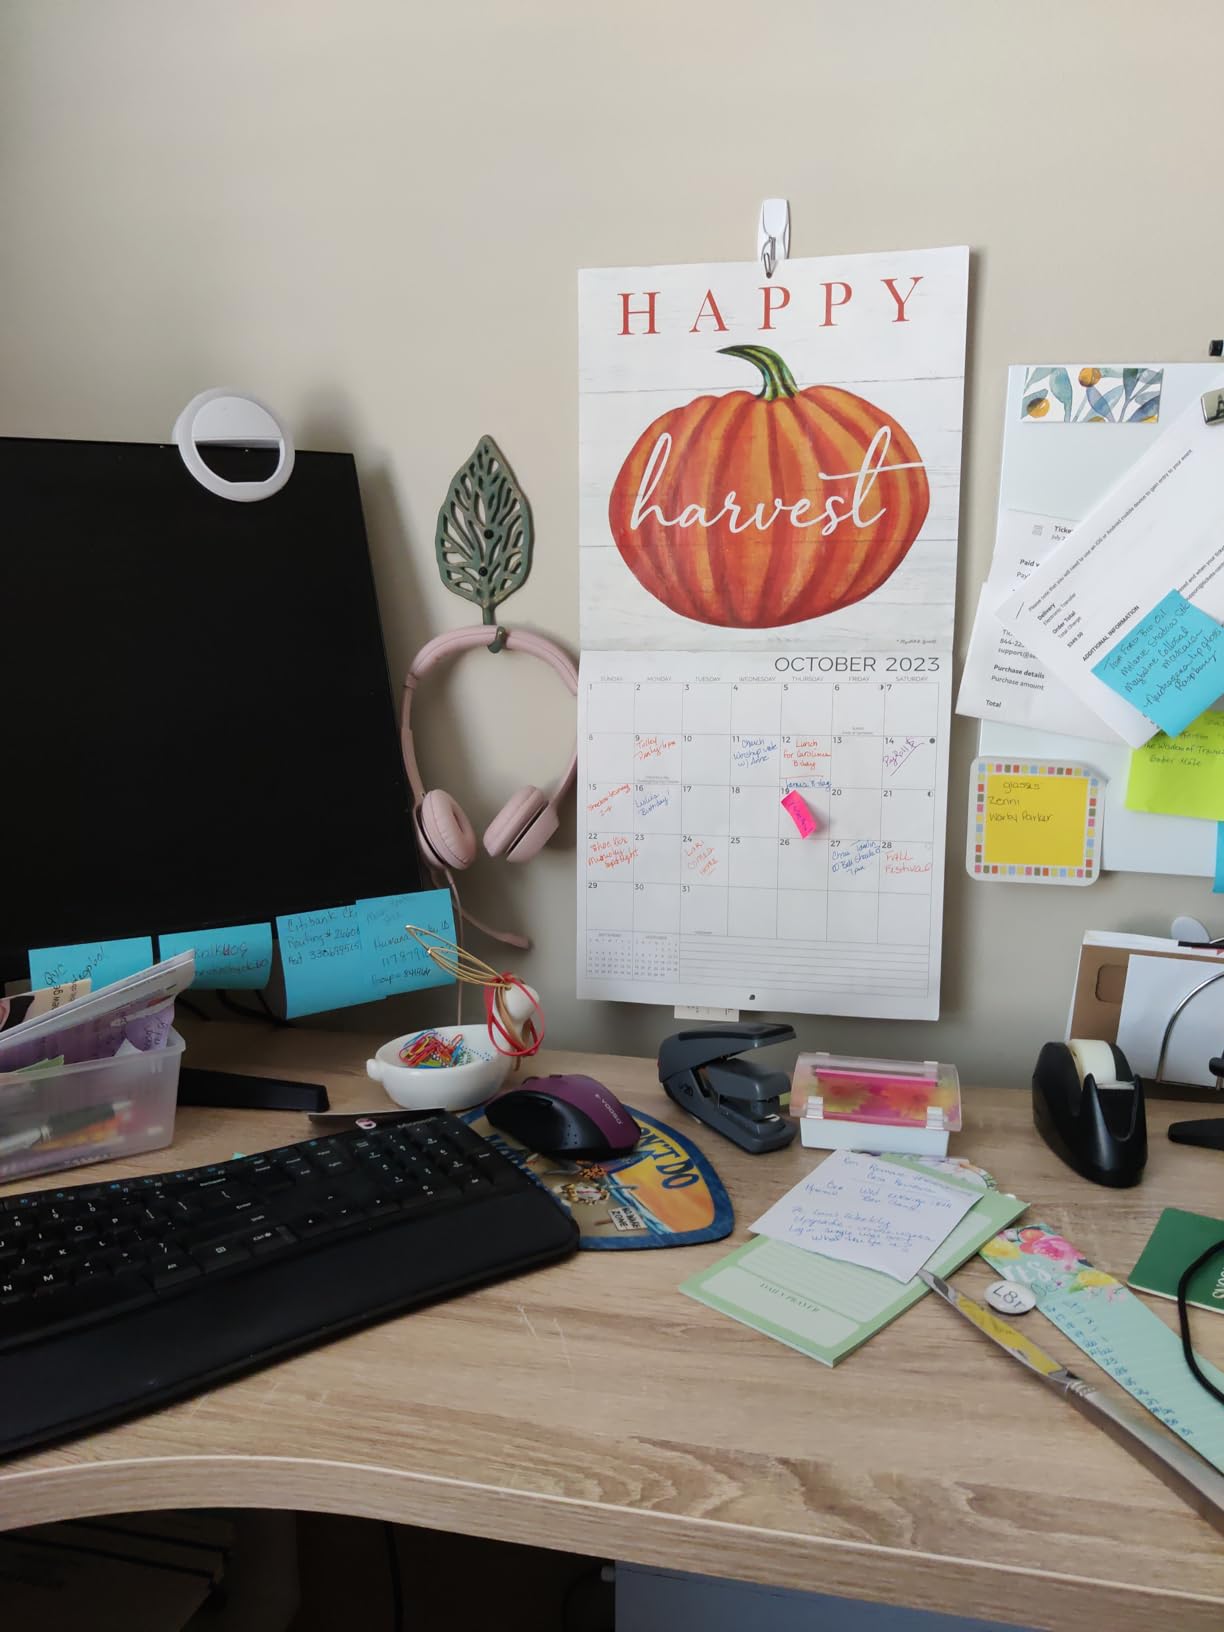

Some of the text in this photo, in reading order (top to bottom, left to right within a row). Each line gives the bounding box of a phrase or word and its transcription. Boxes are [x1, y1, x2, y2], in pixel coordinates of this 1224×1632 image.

[617, 276, 924, 336] HAPPY
[630, 425, 926, 536] harvest
[1019, 558, 1034, 566] Paid
[1036, 601, 1056, 621] Delivery
[1051, 609, 1076, 634] Order Total
[1057, 615, 1082, 639] Total Charge
[1081, 605, 1140, 662] ADDITIONAL INFORMATION
[774, 657, 940, 673] OCTOBER 2023
[993, 664, 1045, 679] Purchase details
[990, 675, 1044, 690] Purchase amount
[985, 698, 1001, 708] Total
[780, 838, 790, 846] 26
[881, 841, 892, 849] 28
[634, 883, 645, 891] 30
[682, 885, 690, 893] 31
[656, 1155, 700, 1190] DO
